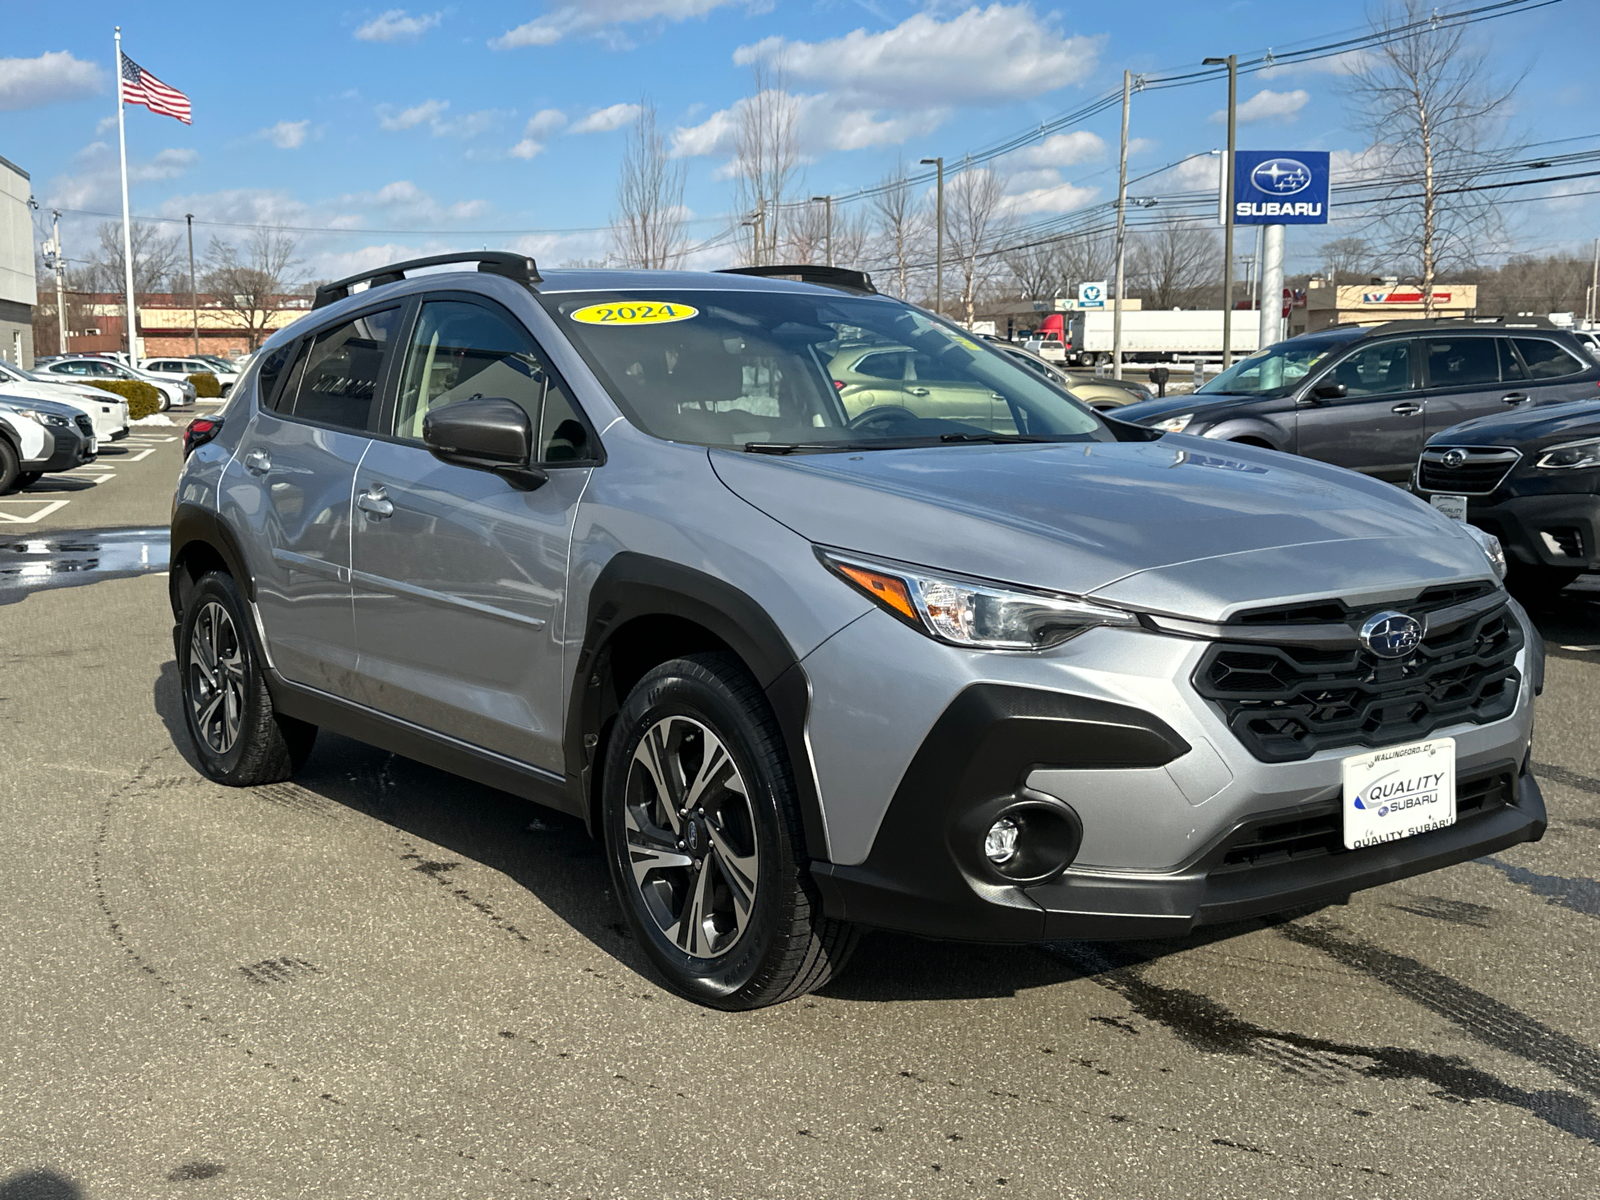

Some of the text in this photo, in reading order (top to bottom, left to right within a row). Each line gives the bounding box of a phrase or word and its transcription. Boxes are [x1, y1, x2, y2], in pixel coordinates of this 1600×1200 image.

[1236, 202, 1322, 216] SUBARU
[596, 305, 678, 322] 2024
[1423, 744, 1432, 752] CT
[1370, 772, 1445, 801] QUALITY
[1390, 793, 1438, 813] SUBARU
[1353, 817, 1454, 849] QUALITY SUBARU
